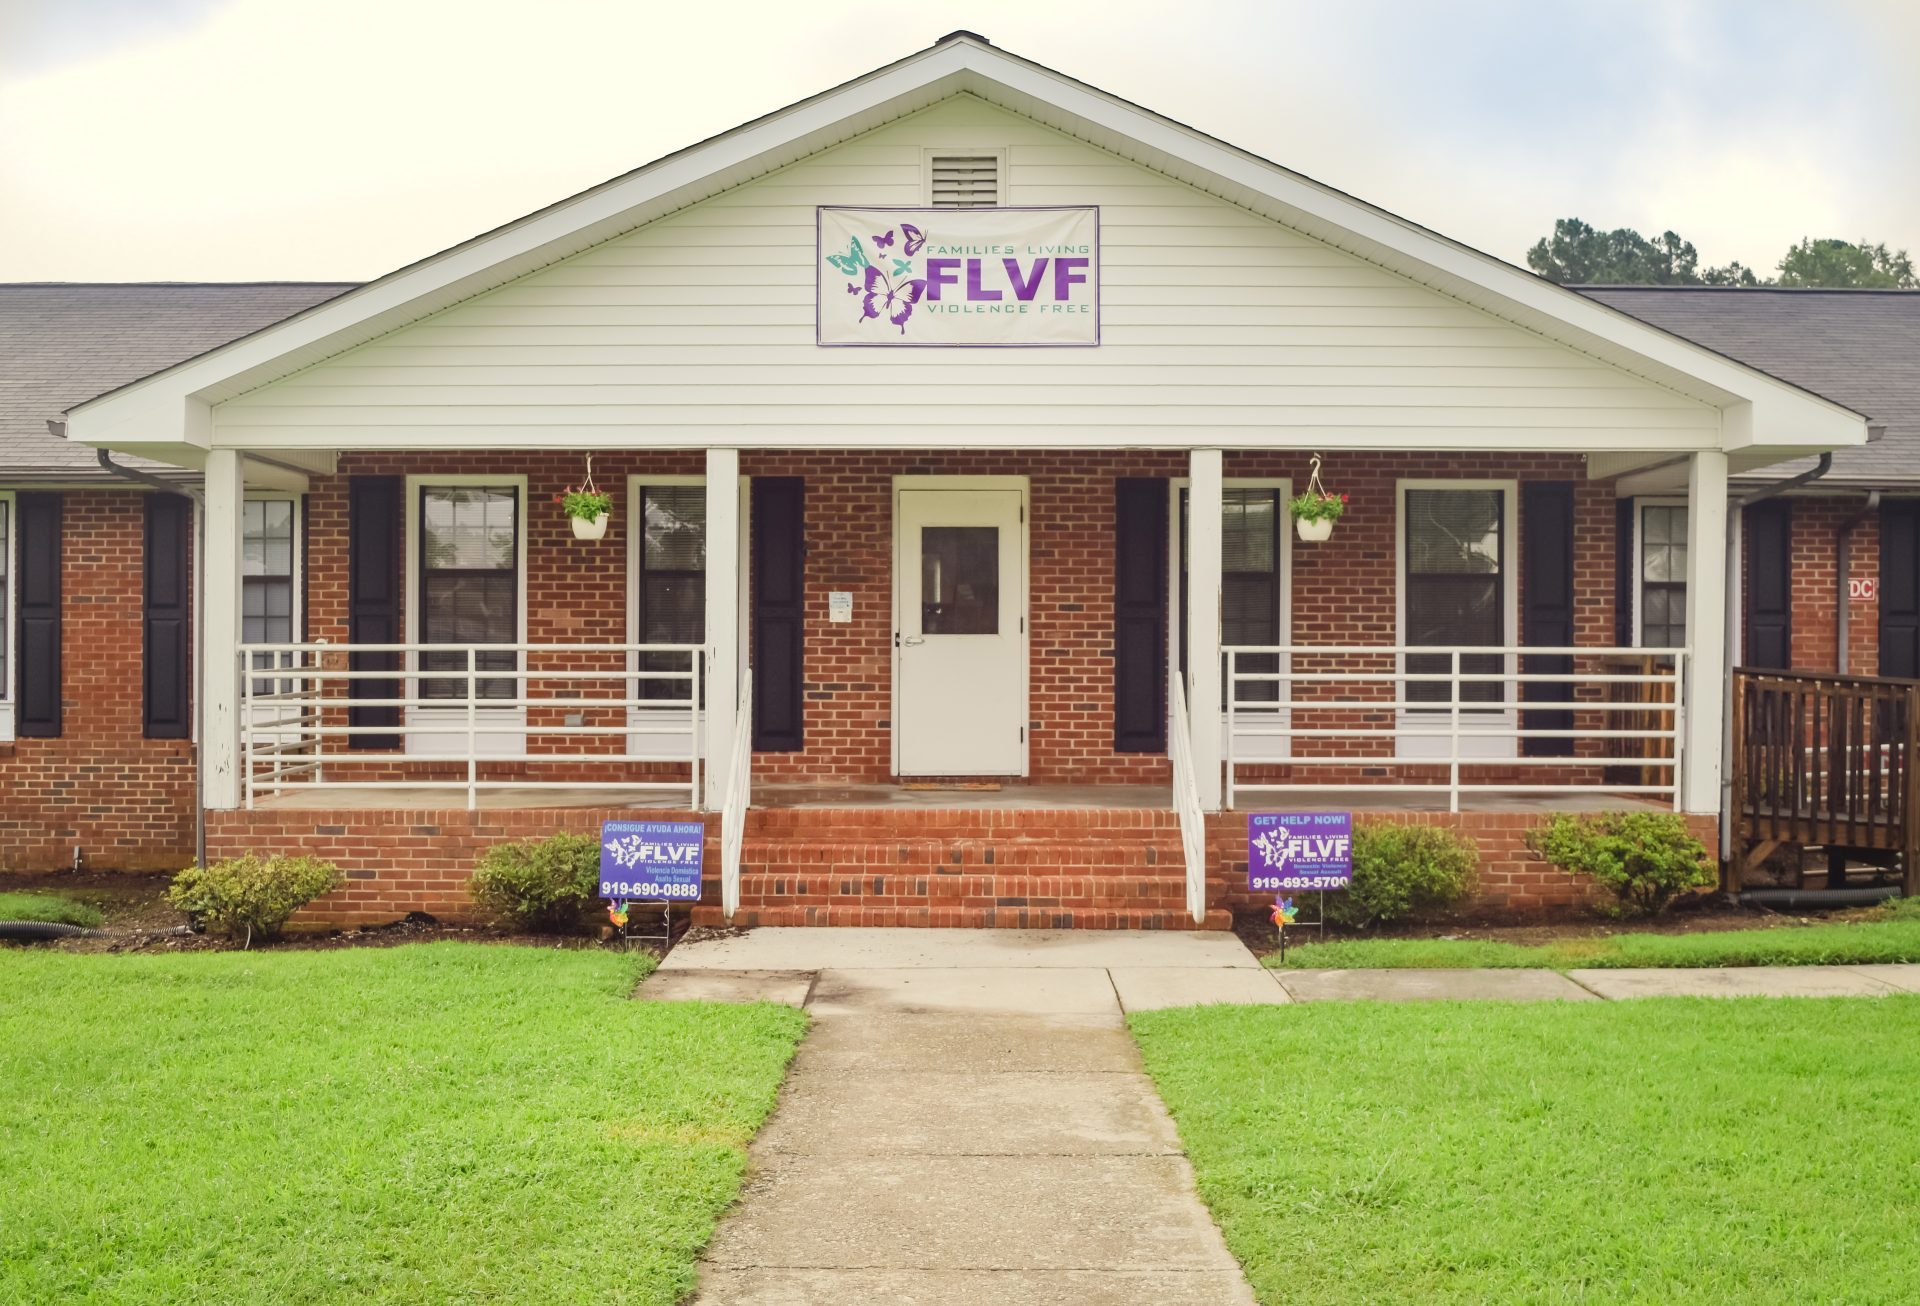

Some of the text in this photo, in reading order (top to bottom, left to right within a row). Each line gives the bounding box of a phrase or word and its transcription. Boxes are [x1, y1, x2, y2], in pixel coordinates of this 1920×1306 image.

[927, 245, 1089, 255] FAMILIES LIVING
[927, 257, 1089, 301] FLVF
[928, 304, 1089, 313] VIOLENCE FREE
[1848, 580, 1872, 598] DC
[1254, 815, 1346, 825] GET HELP NOW!
[604, 823, 701, 834] ¡CONSIGUE AYUDA AHORA!
[640, 845, 700, 861] FLVF
[1288, 839, 1349, 858] FLVF
[602, 882, 698, 897] 919-690-0888
[1252, 876, 1349, 889] 919-693-5700
